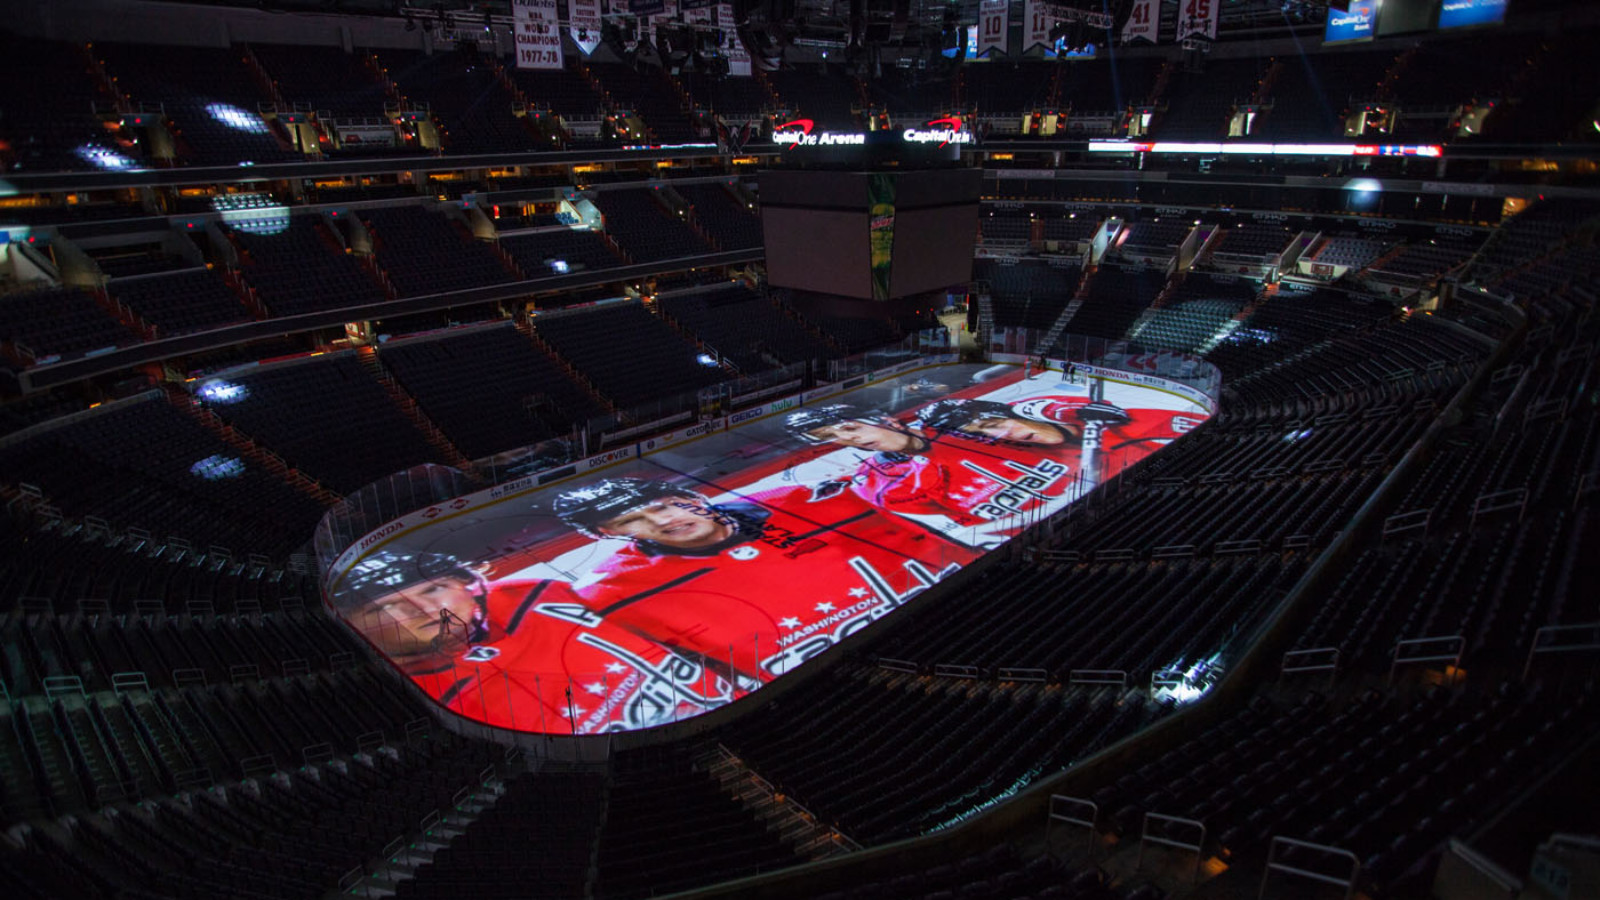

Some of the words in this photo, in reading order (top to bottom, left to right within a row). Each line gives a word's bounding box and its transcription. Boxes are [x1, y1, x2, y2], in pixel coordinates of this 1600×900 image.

[1132, 3, 1150, 24] 41
[1186, 0, 1210, 18] 45
[525, 24, 549, 33] WOLD
[985, 16, 1001, 35] 10
[1033, 13, 1045, 33] 11
[517, 34, 560, 45] CHAMPIONS
[819, 132, 865, 144] Arena
[1095, 368, 1129, 379] HONDA
[771, 399, 792, 411] hulu
[731, 408, 763, 424] GEICO
[589, 448, 629, 468] DISCOVER
[360, 522, 404, 549] HONDA
[777, 597, 879, 646] WASHINGTON
